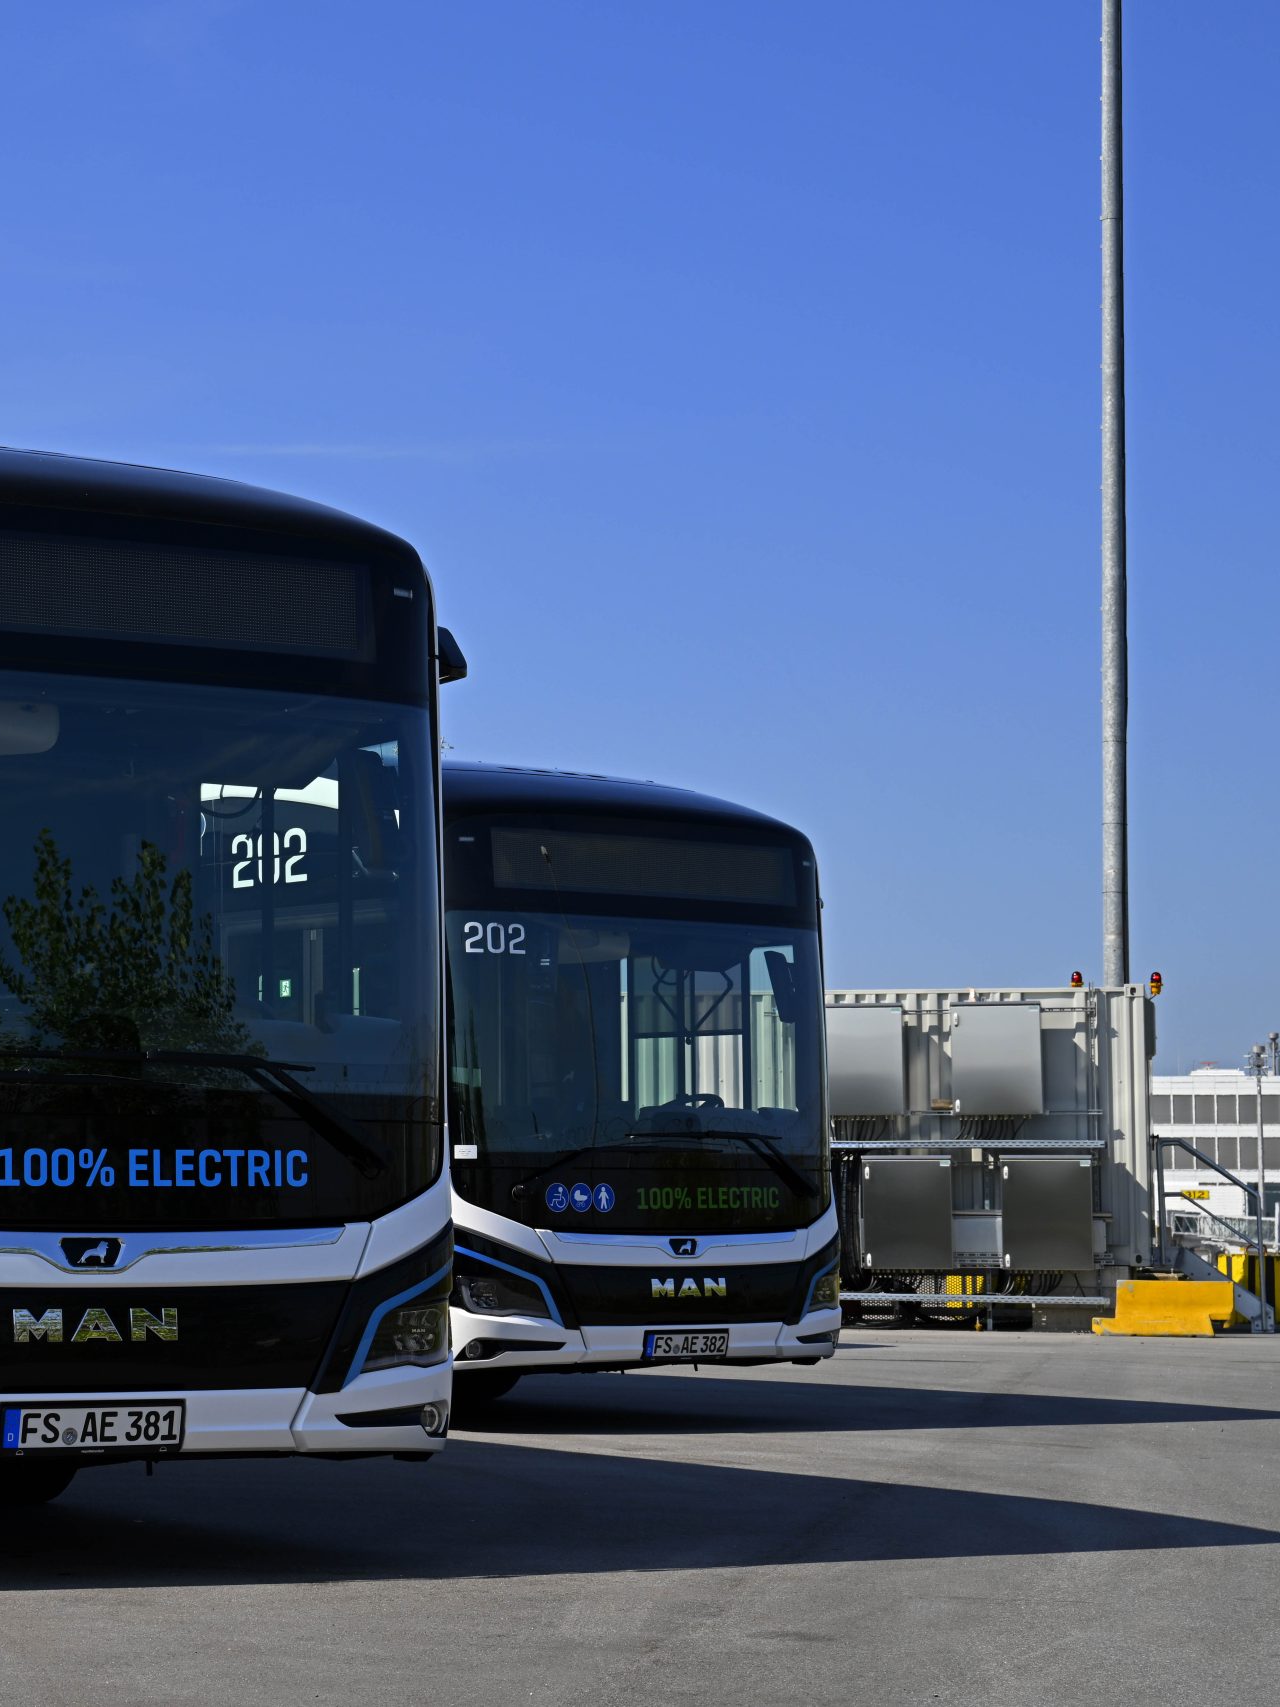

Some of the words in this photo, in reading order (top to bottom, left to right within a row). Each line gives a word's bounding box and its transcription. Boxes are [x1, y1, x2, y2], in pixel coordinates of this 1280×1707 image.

[464, 922, 526, 955] 202
[129, 1148, 309, 1188] ELECTRIC
[637, 1187, 692, 1210] 100%
[697, 1186, 780, 1209] ELECTRIC
[651, 1277, 727, 1298] MAN
[13, 1307, 179, 1342] MAN
[654, 1336, 673, 1354] FS
[680, 1336, 700, 1354] AE
[700, 1335, 726, 1354] 382
[7, 1432, 14, 1442] D
[21, 1412, 61, 1444] FS
[80, 1411, 118, 1443] AE
[125, 1410, 177, 1442] 381
